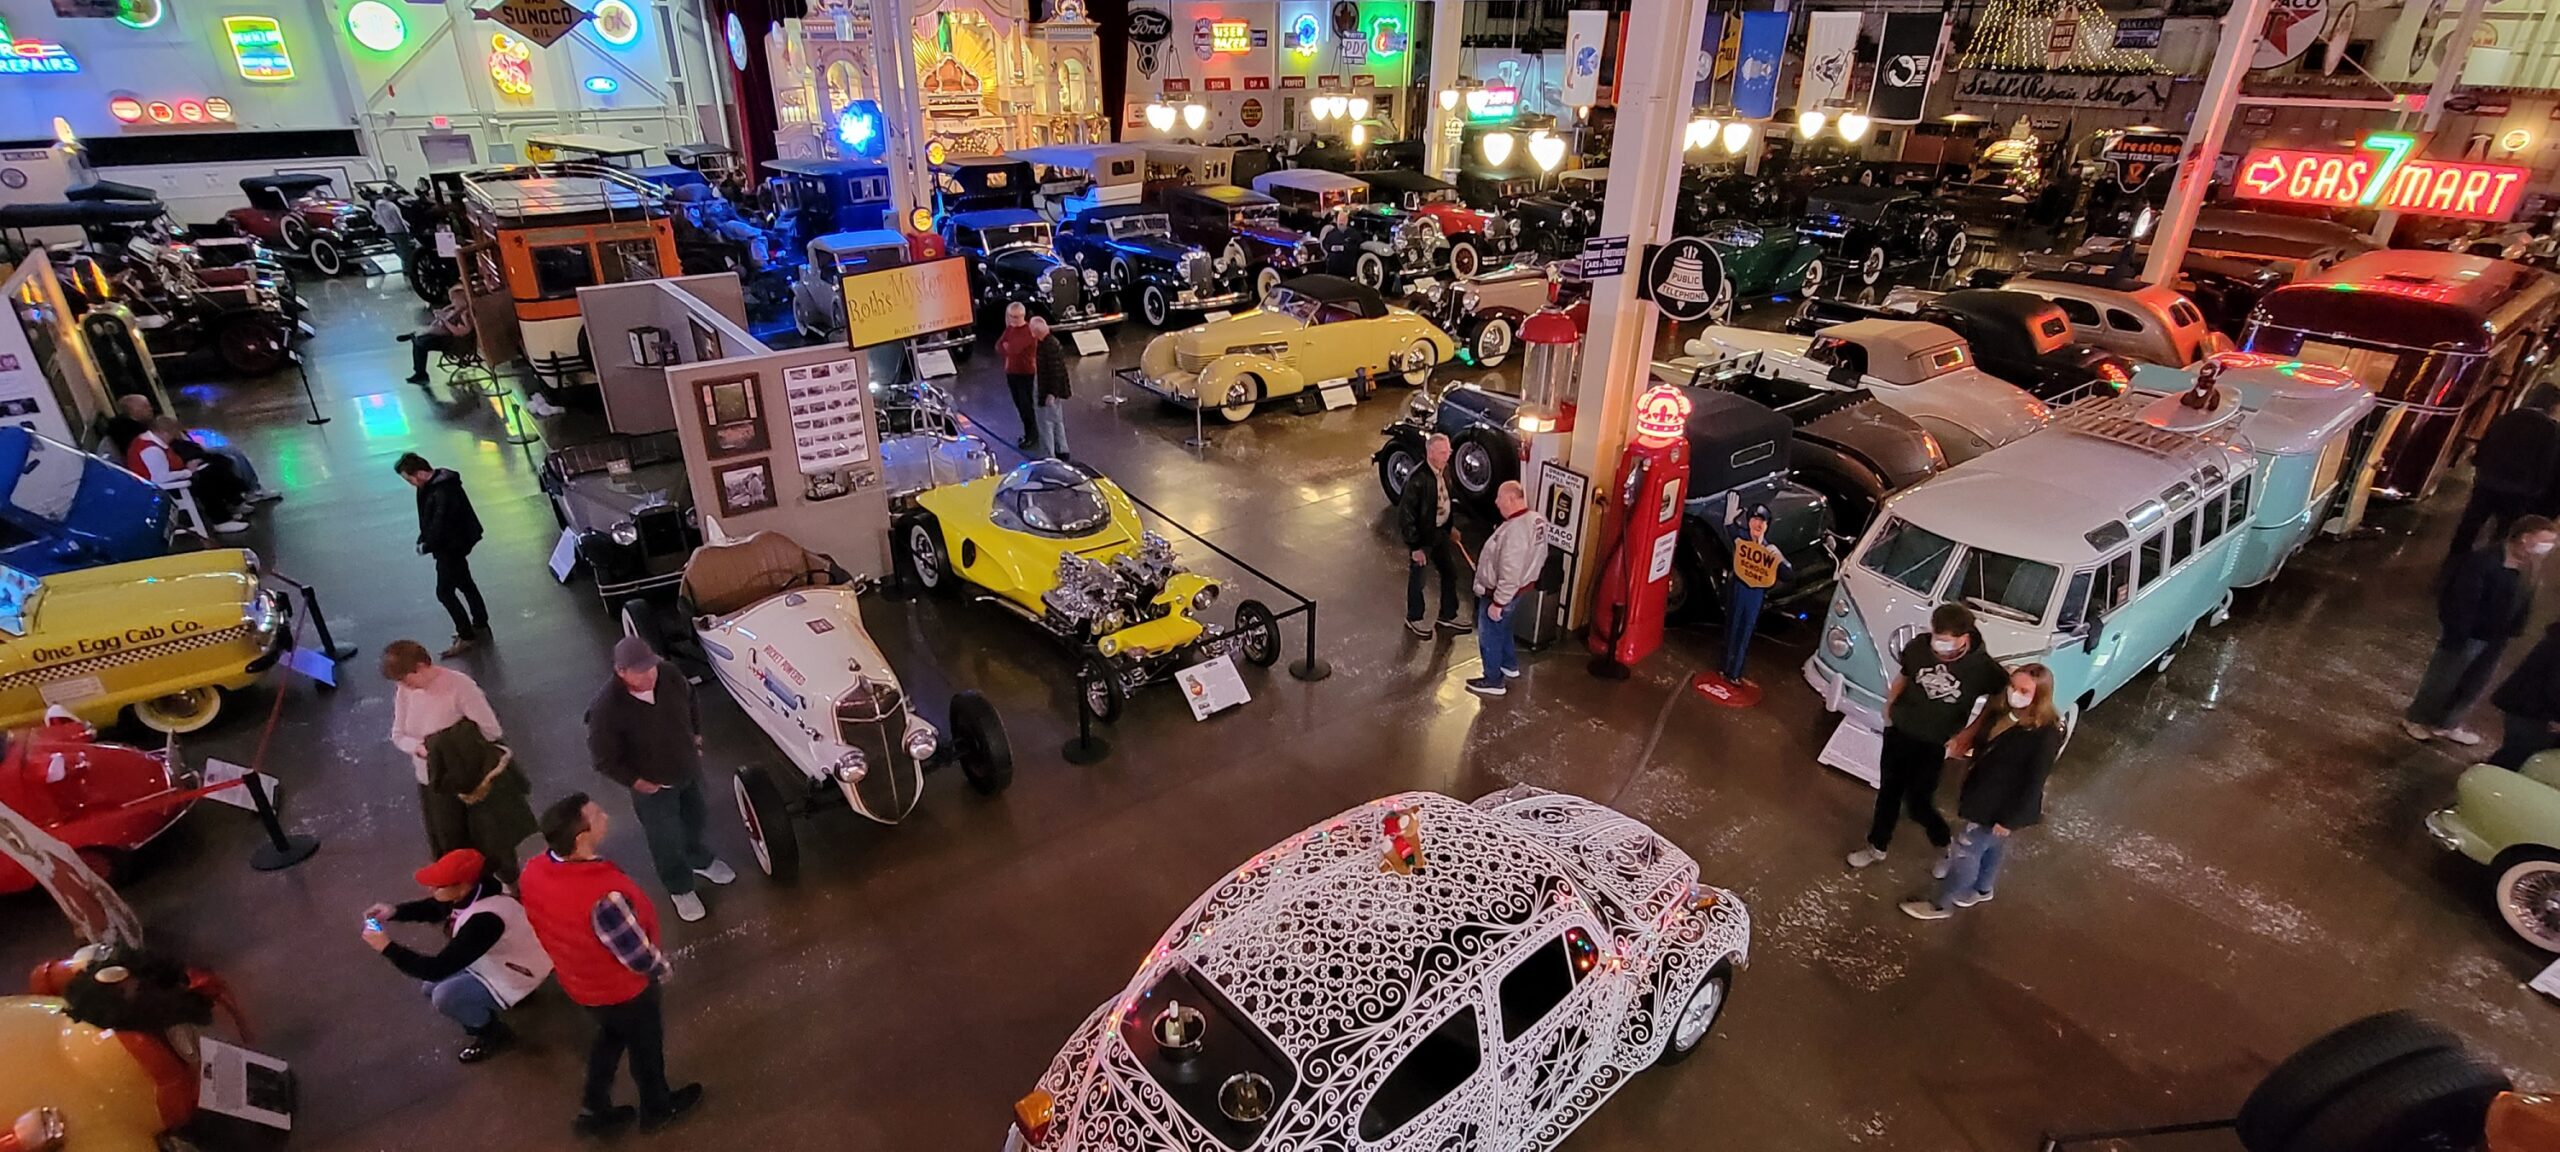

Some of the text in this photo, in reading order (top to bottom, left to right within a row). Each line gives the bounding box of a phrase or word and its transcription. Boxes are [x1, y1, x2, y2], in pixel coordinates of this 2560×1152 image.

[502, 5, 573, 25] SUNOCO
[532, 27, 552, 38] OIL
[1128, 14, 1167, 35] Ford
[0, 57, 80, 73] REPAIRS
[2083, 78, 2148, 107] Shop
[2116, 140, 2181, 154] irestone
[2128, 153, 2153, 161] TIRES
[2288, 134, 2518, 215] GAS 7 MART
[1671, 272, 1700, 285] PUBLIC
[1662, 285, 1706, 300] TELEPHONE
[848, 290, 893, 323] Roth's
[1546, 523, 1573, 541] XACO
[1739, 544, 1776, 569] SLOW
[1741, 560, 1768, 577] SCHOOL
[33, 620, 204, 664] One Egg Cab Co.
